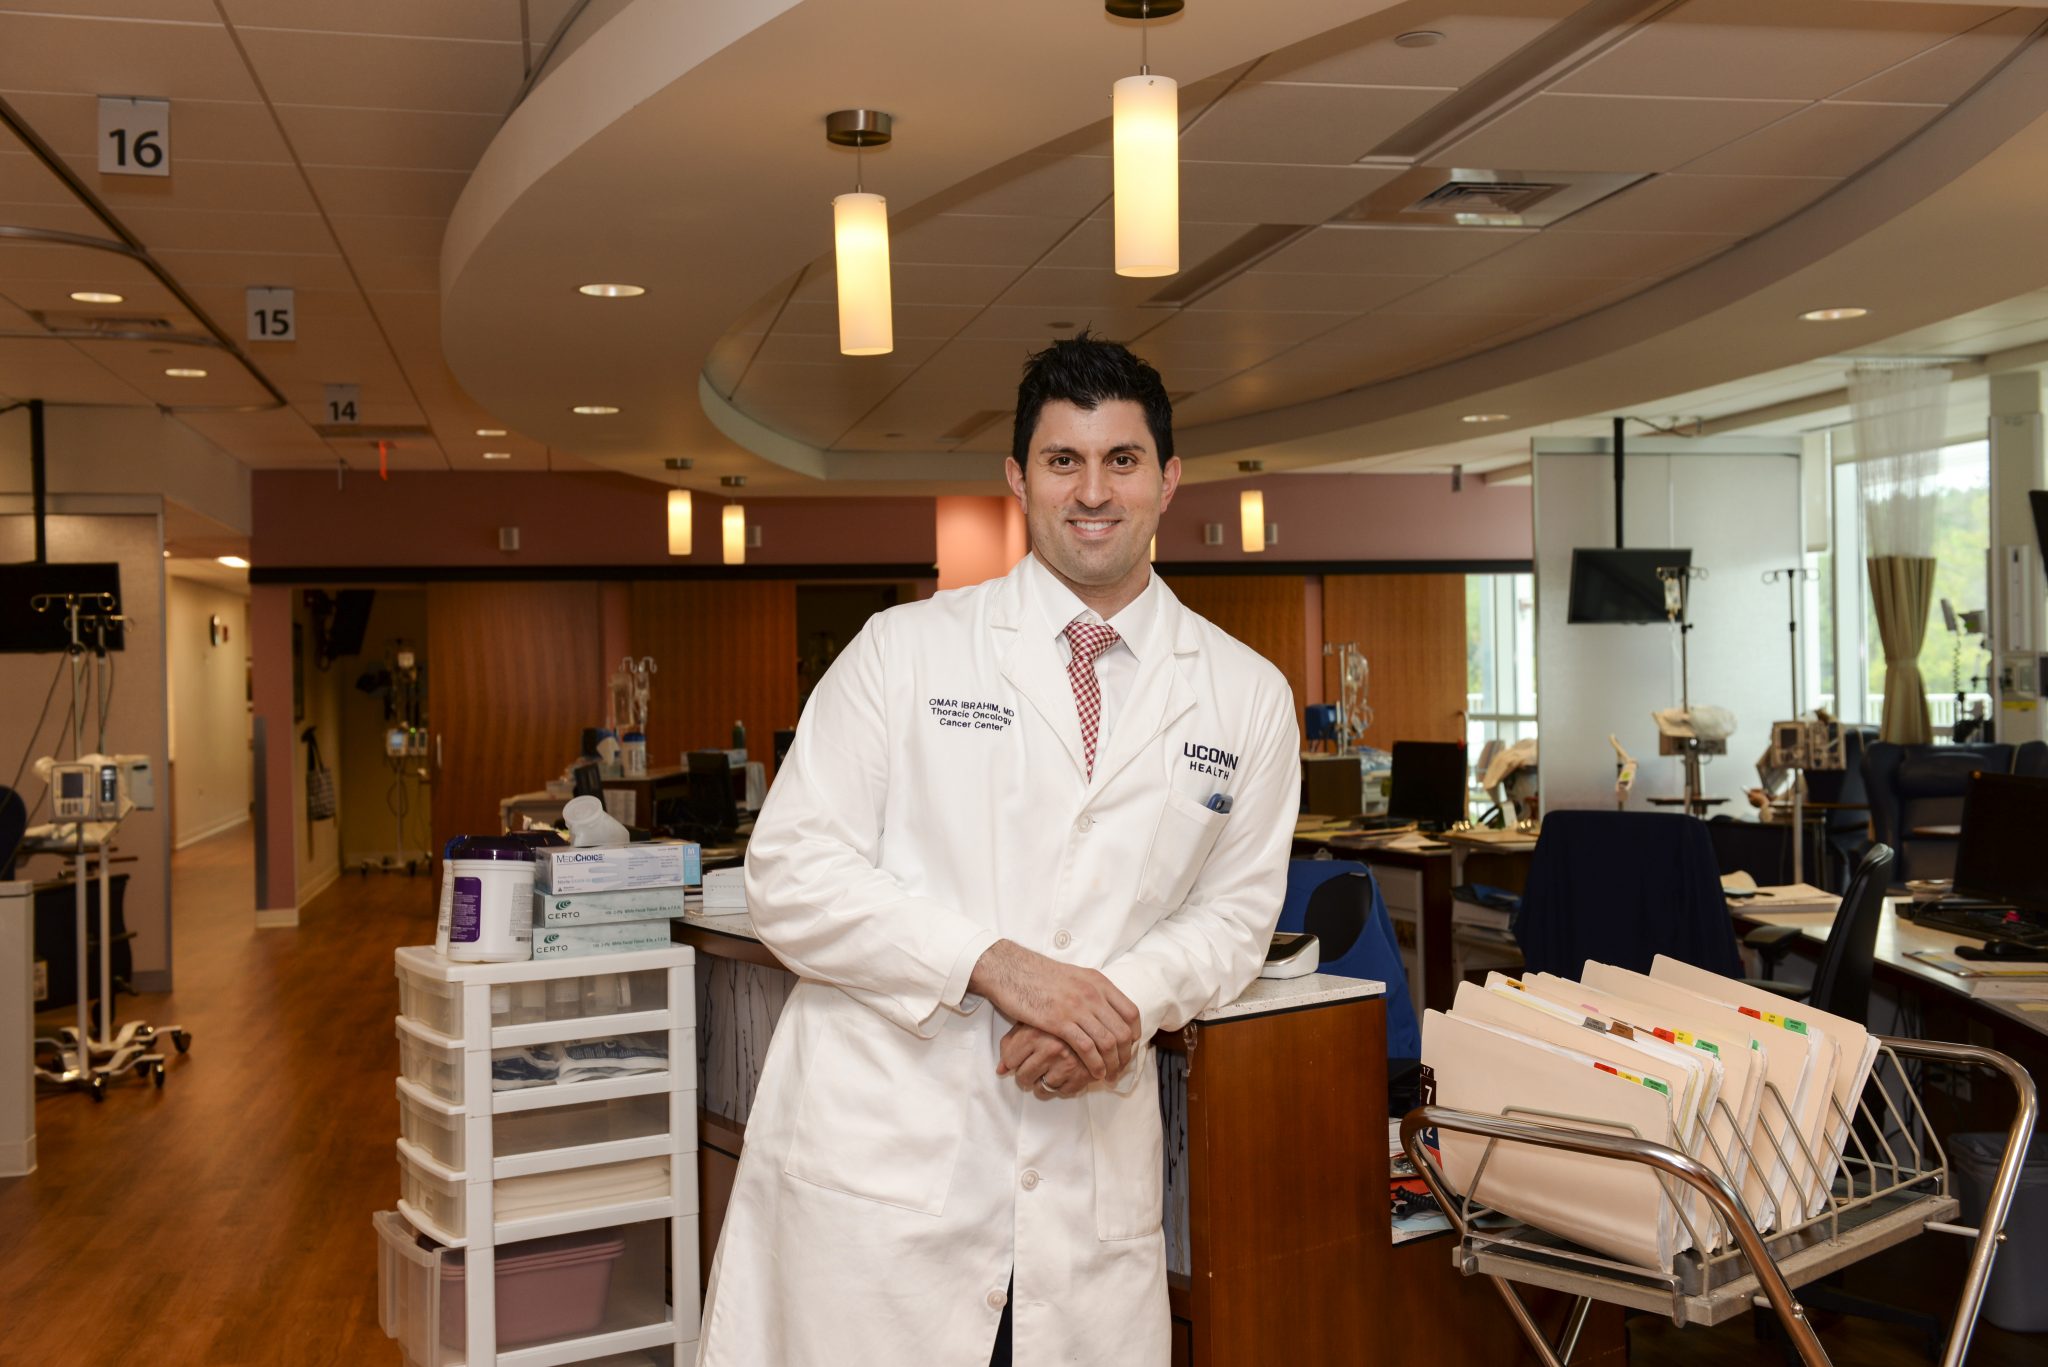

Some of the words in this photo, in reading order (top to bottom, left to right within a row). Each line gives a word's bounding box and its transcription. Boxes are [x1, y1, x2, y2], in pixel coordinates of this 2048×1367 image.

[109, 129, 163, 168] 16
[254, 310, 289, 336] 15
[329, 401, 357, 421] 14
[929, 698, 958, 708] OMAR
[961, 701, 1001, 713] IBRAHIM,
[1003, 707, 1015, 717] MD
[931, 707, 970, 718] Thoracic
[972, 711, 1012, 725] Oncology
[939, 718, 971, 728] Cancer
[974, 721, 1004, 731] Center
[1184, 742, 1239, 770] UCONN
[1190, 761, 1230, 781] HEALTH
[547, 911, 580, 920] CERTO
[536, 944, 568, 954] CERTO
[1423, 1066, 1431, 1076] 17
[1425, 1084, 1433, 1105] 7
